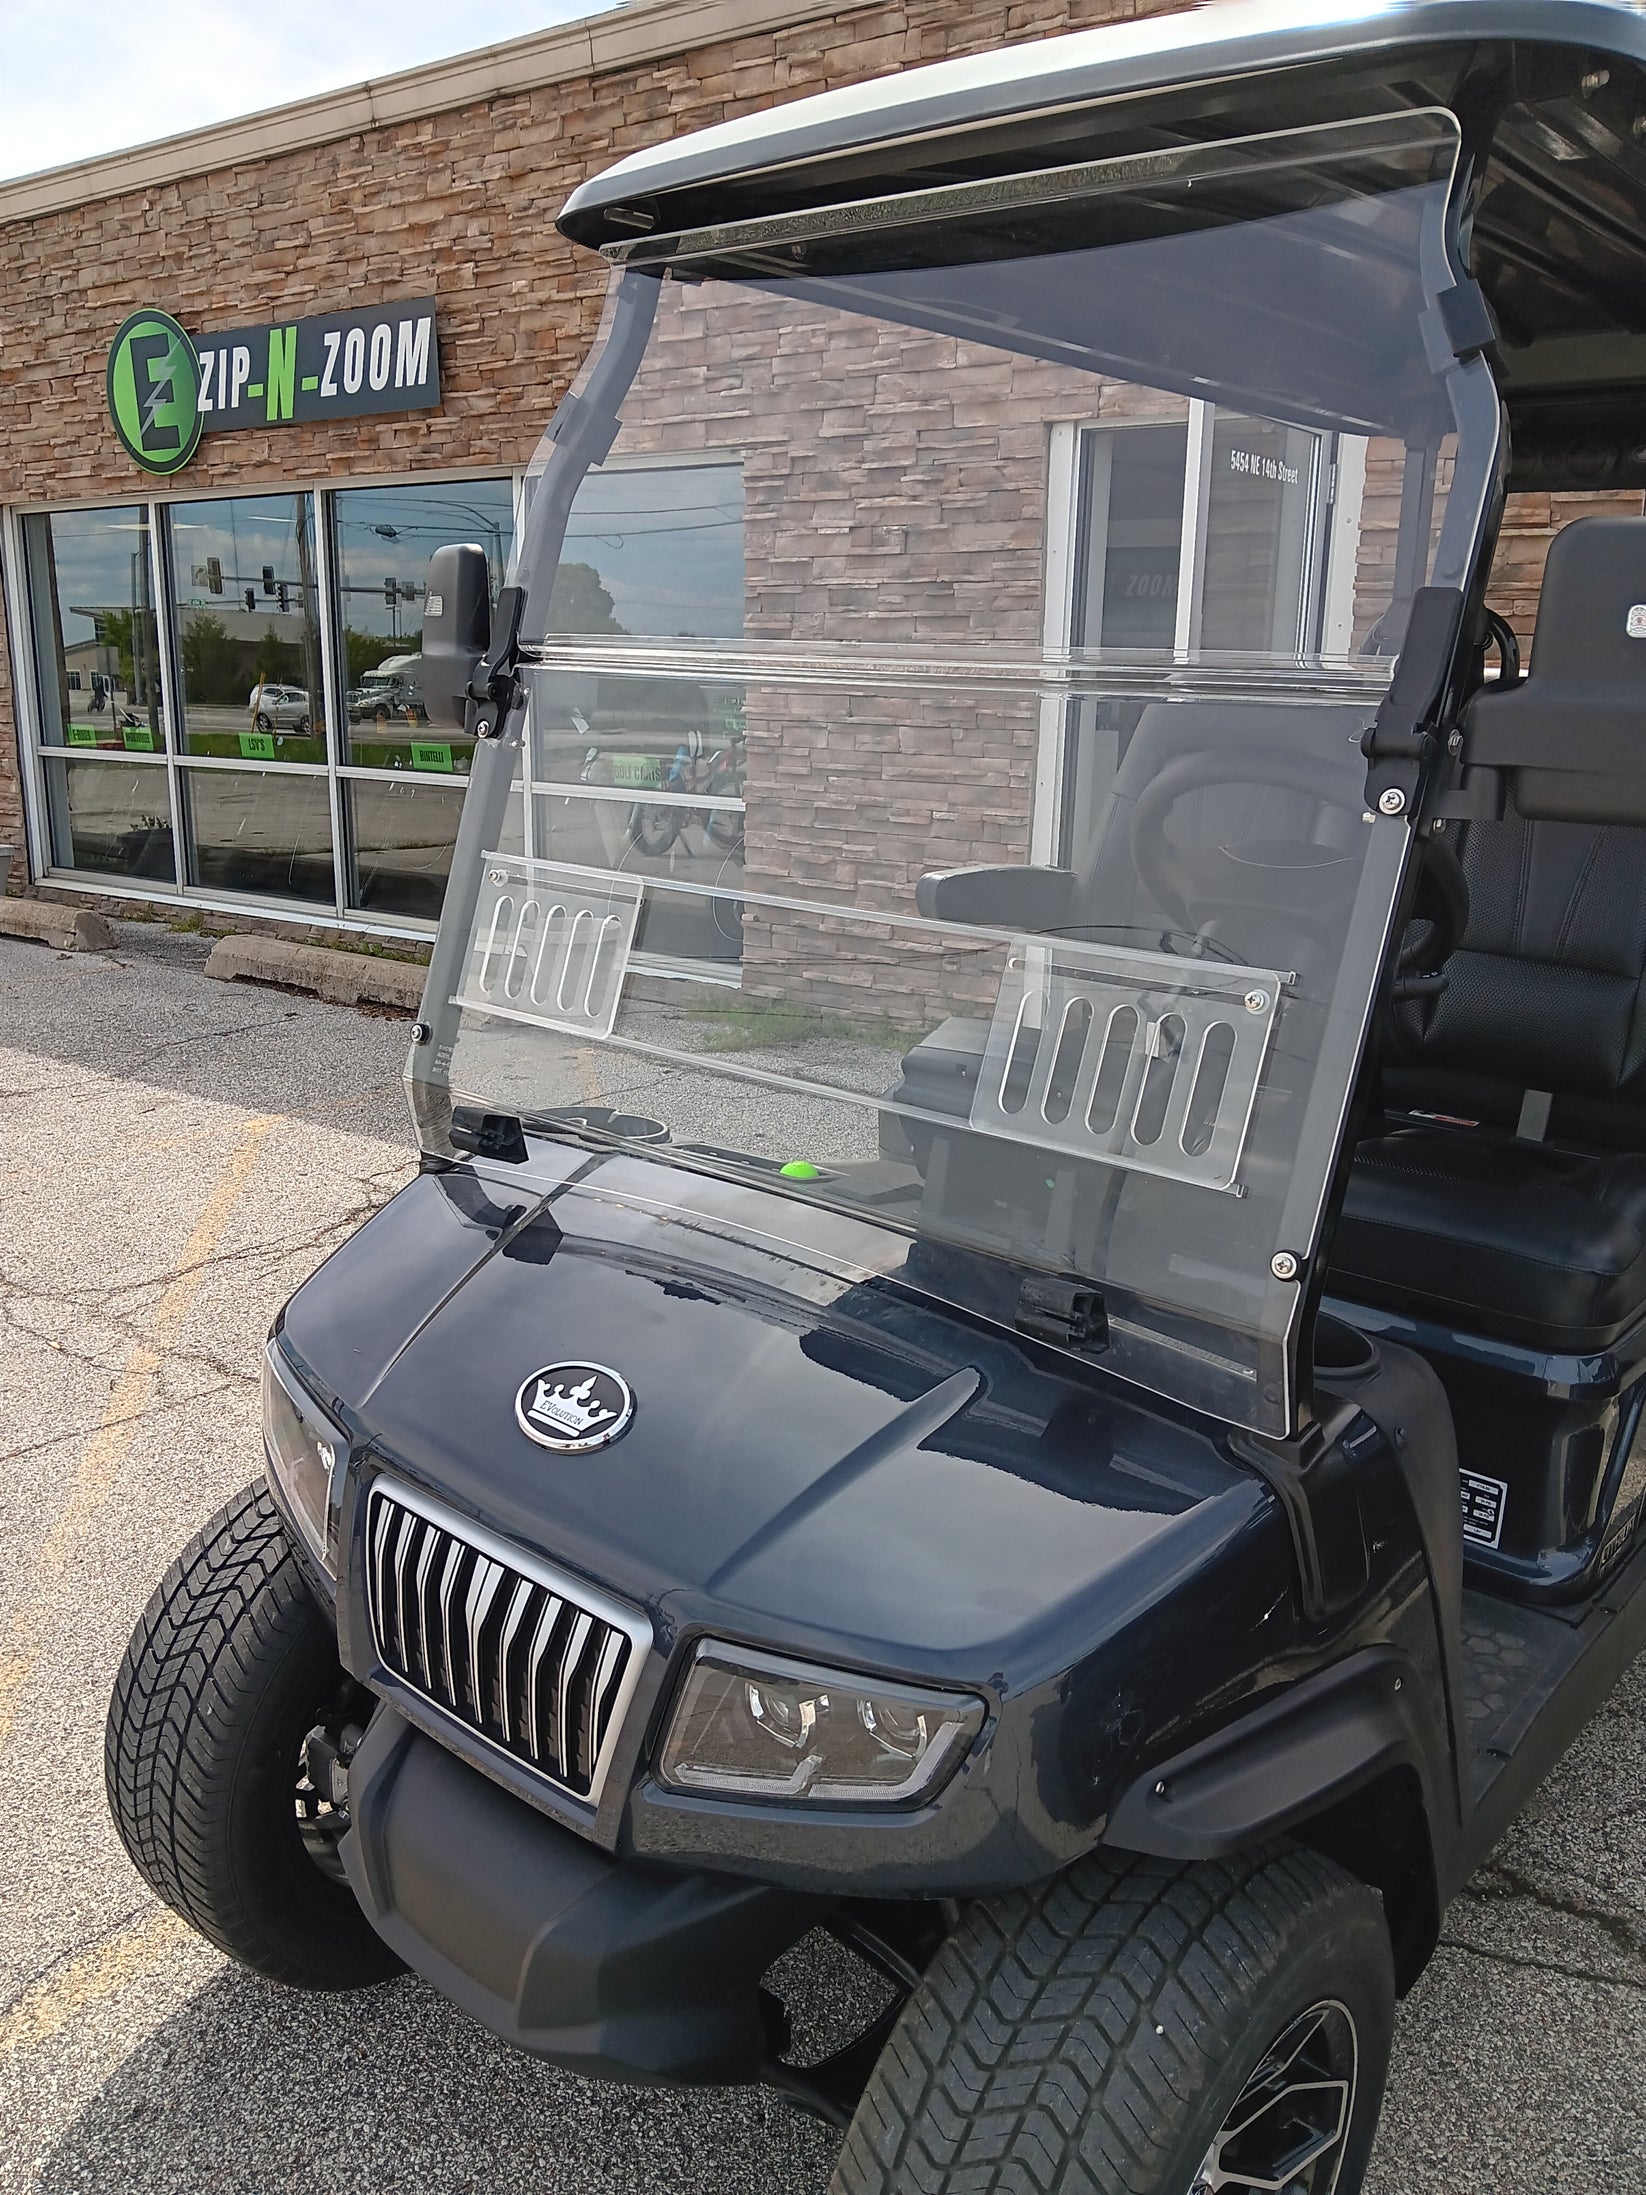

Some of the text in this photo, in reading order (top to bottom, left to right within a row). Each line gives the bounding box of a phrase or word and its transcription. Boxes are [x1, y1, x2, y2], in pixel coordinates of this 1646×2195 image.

[197, 316, 432, 421] ZIP-N-ZOOM
[1230, 449, 1299, 484] 5454 NE 14th Street
